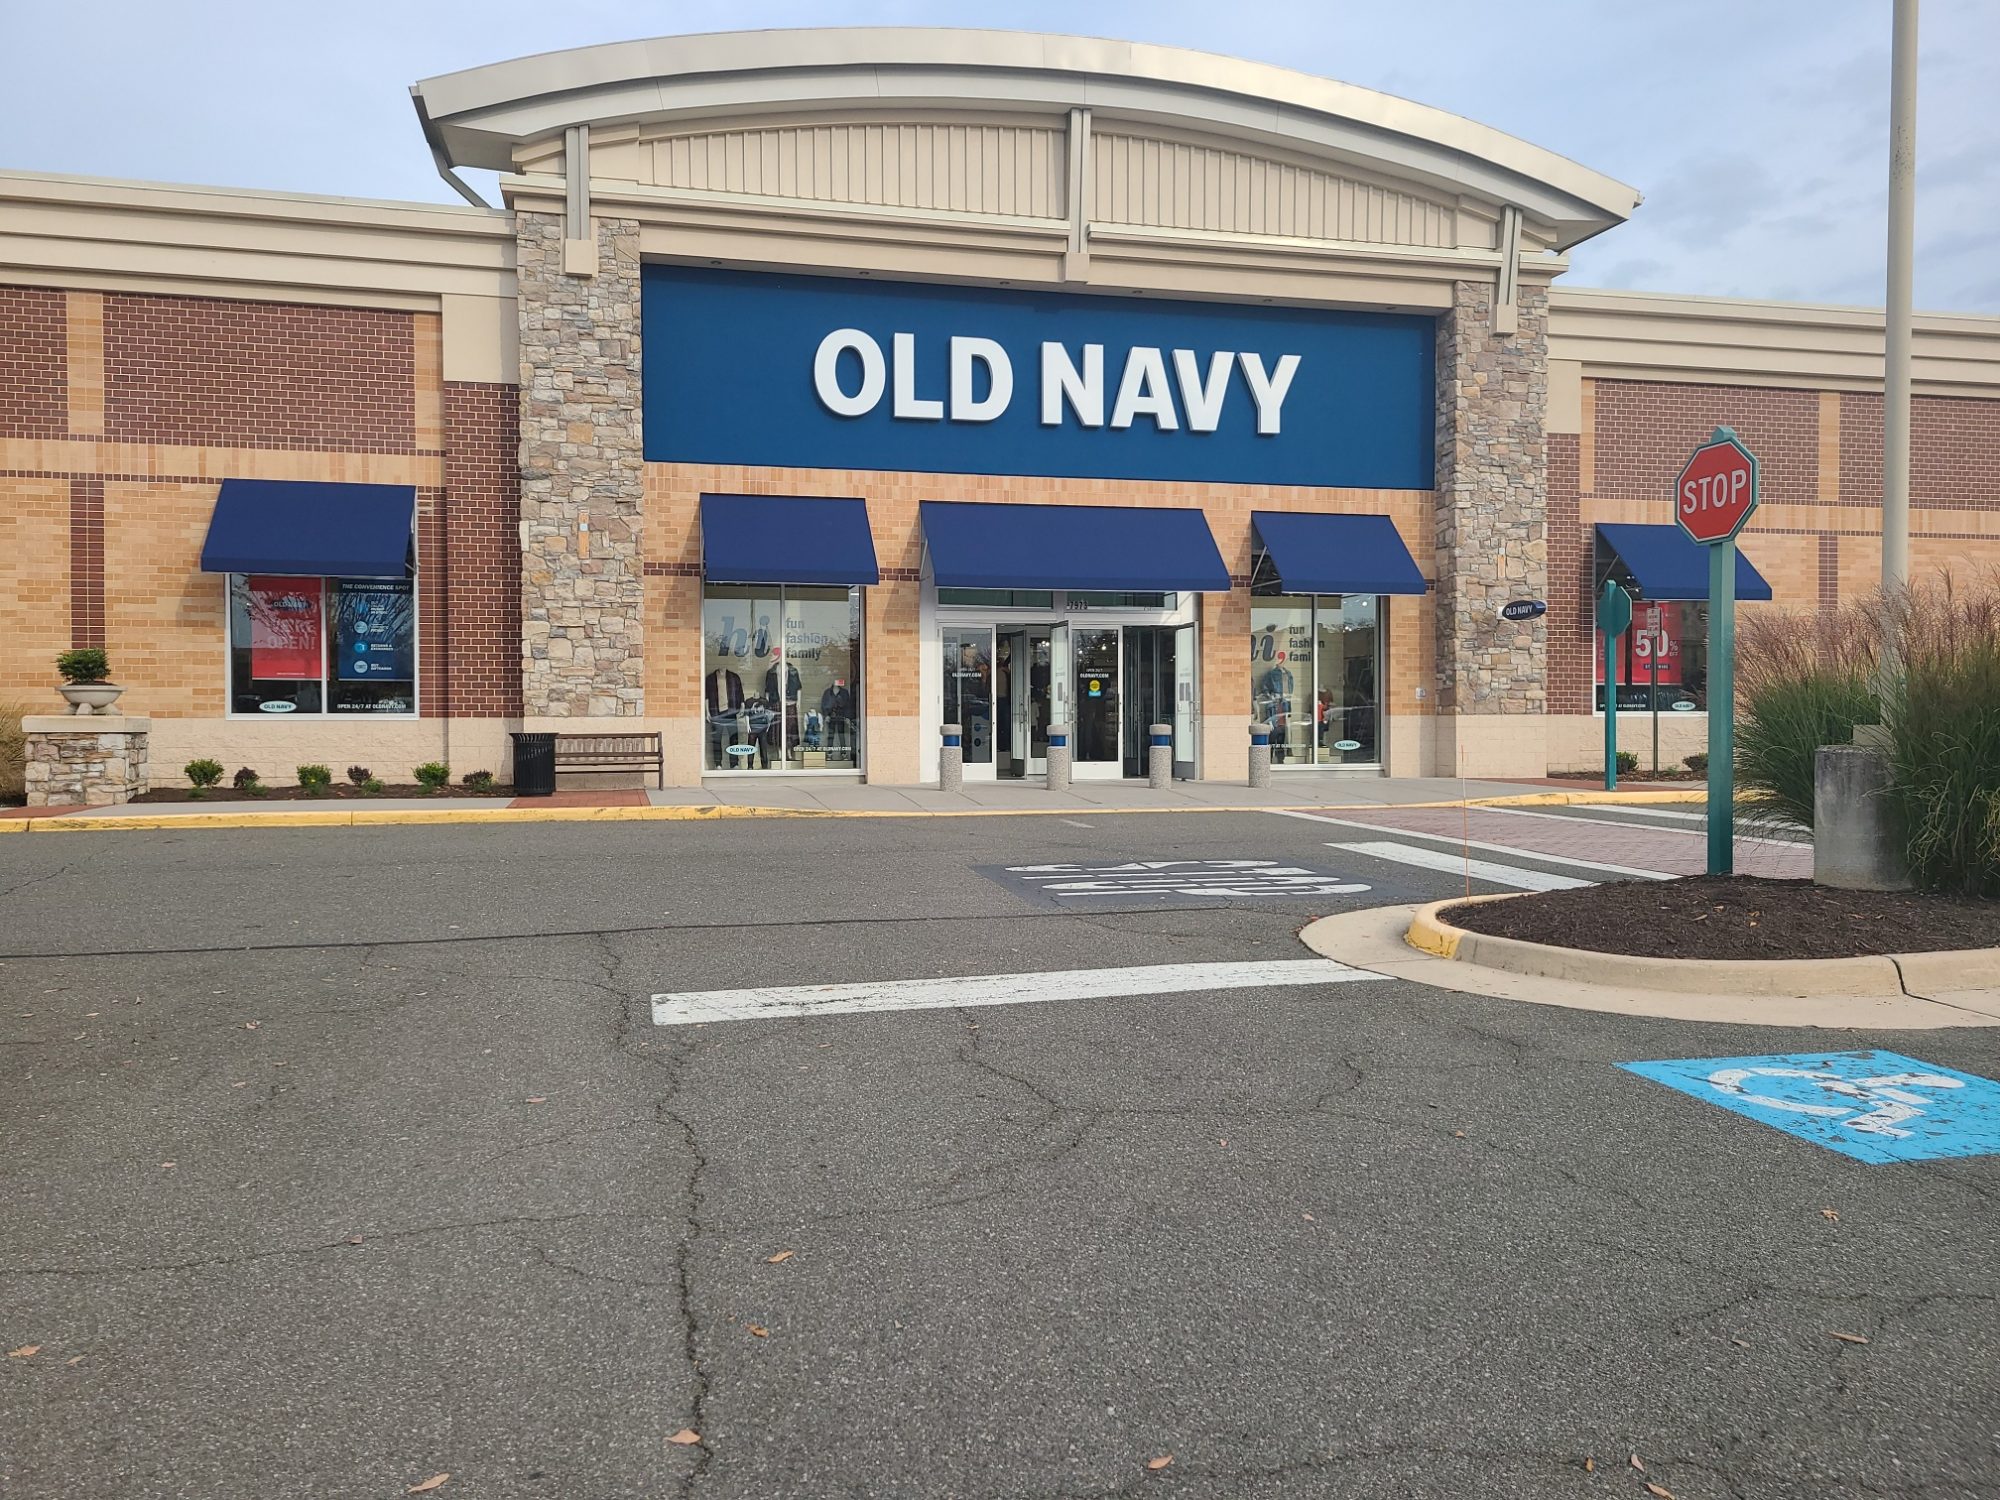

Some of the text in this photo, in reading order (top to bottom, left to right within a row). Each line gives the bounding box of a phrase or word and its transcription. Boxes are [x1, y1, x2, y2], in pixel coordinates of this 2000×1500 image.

[813, 327, 1303, 435] OLD NAVY
[1682, 469, 1747, 514] STOP
[1505, 604, 1533, 616] OLD NAVY
[786, 617, 805, 629] fun
[1289, 626, 1305, 635] fun
[786, 632, 829, 645] fashion
[1289, 637, 1325, 649] fashin
[786, 647, 821, 661] family
